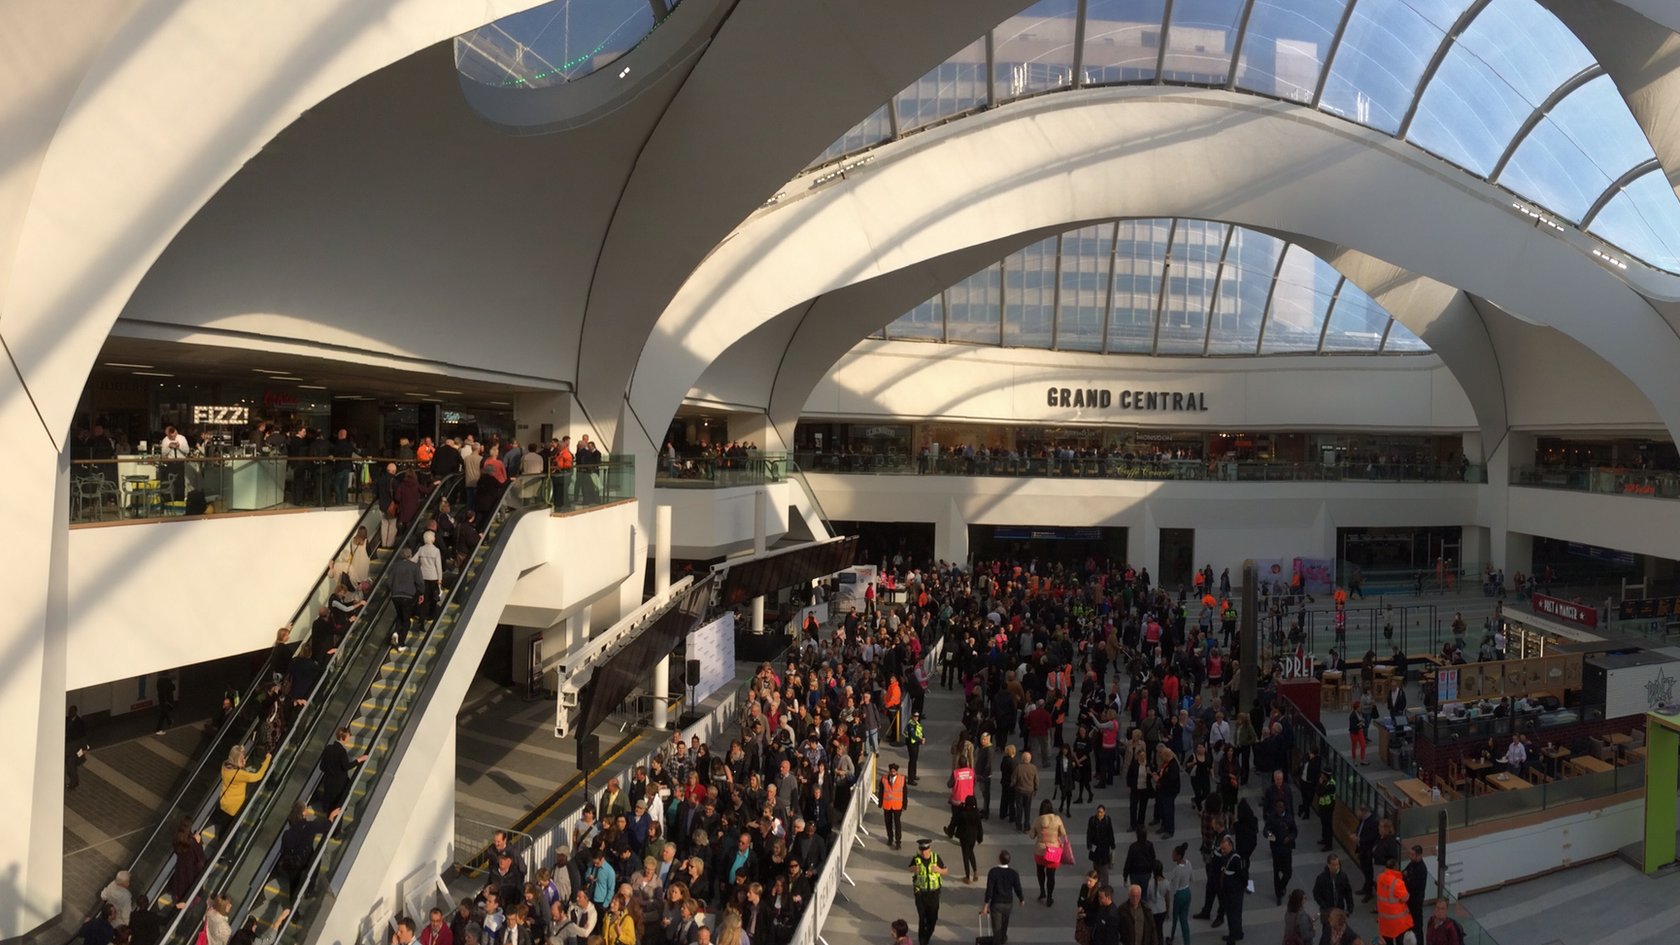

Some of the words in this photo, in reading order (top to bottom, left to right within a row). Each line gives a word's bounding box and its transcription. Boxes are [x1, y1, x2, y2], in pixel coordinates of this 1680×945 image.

[1047, 387, 1112, 409] GRAND
[1121, 390, 1209, 412] CENTRAL
[193, 406, 249, 425] FIZZ!
